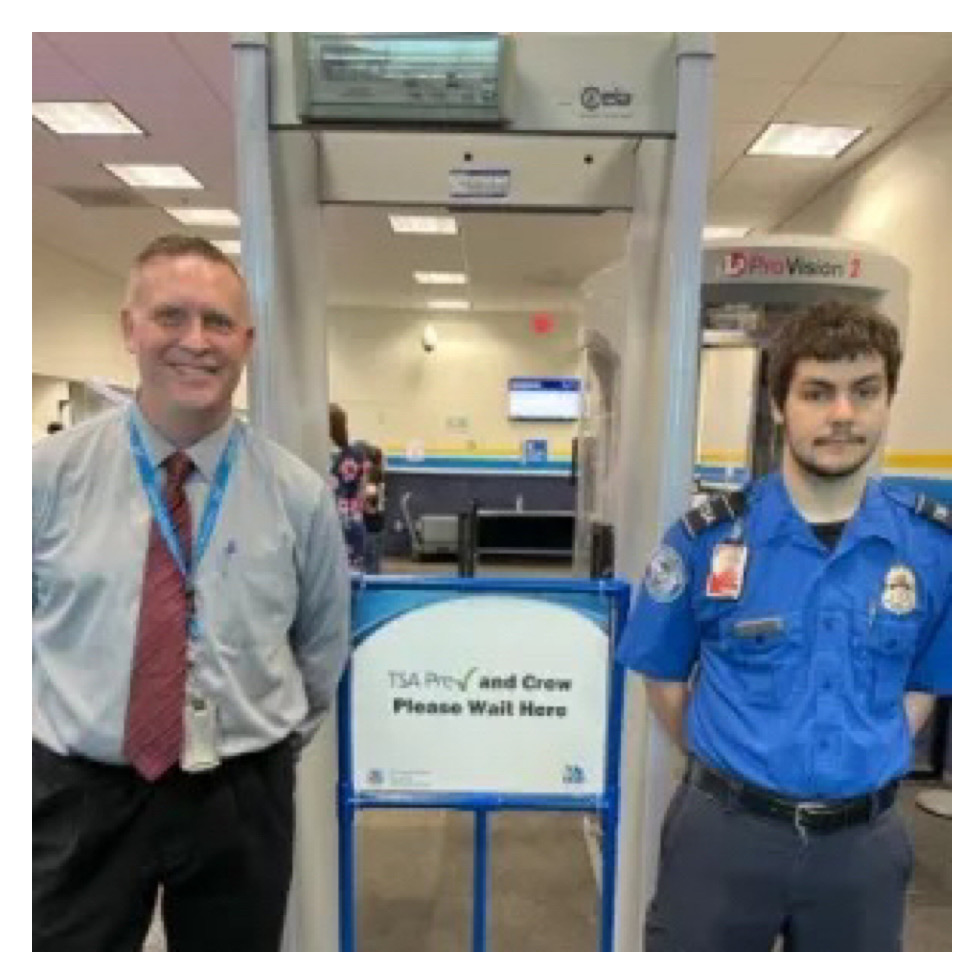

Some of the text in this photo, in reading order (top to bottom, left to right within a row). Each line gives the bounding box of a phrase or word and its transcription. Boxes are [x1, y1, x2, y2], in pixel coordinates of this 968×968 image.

[749, 254, 844, 278] ProVision
[388, 670, 419, 689] TSA
[479, 674, 517, 690] and
[521, 675, 573, 692] Crew
[392, 698, 568, 718] Please Wait Here
